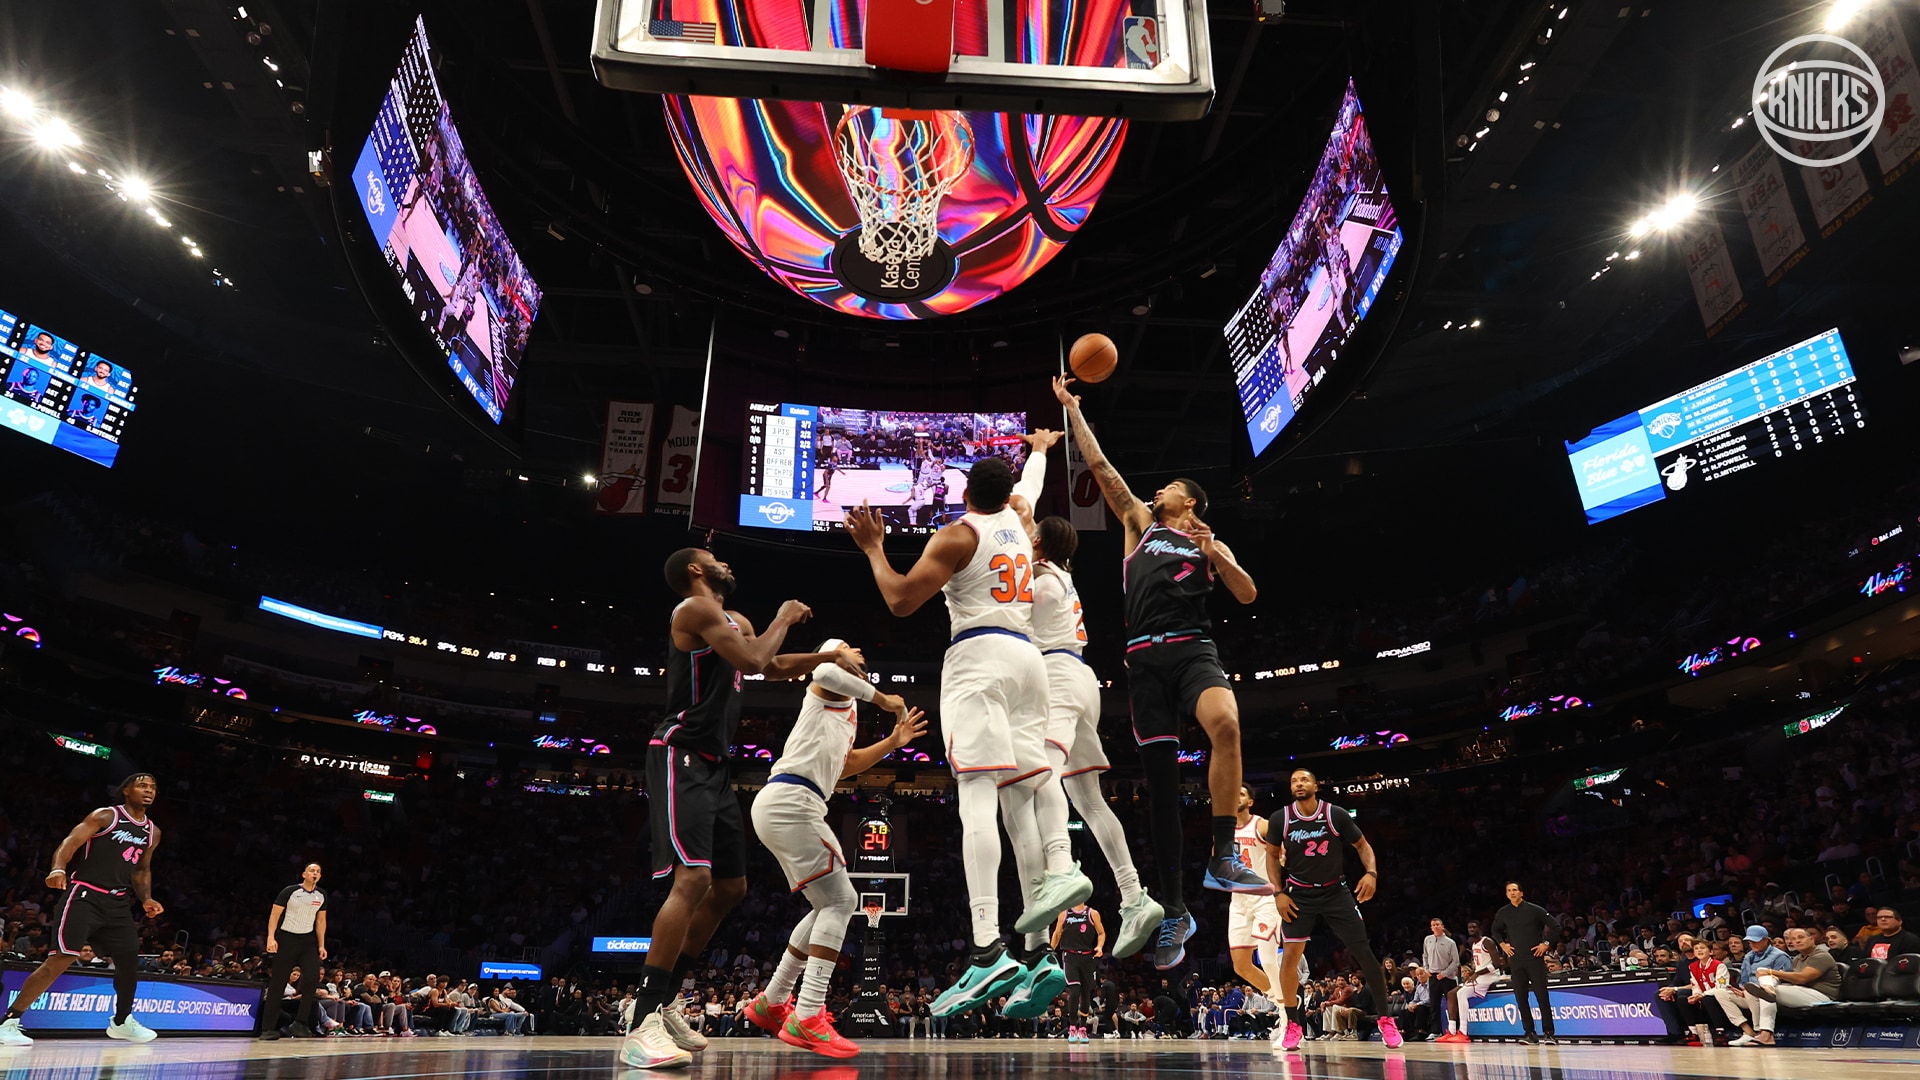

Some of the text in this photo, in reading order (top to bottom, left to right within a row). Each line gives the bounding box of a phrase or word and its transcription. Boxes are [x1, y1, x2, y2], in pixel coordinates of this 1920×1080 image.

[1312, 365, 1326, 387] MIA
[1362, 296, 1370, 311] 10
[1371, 267, 1385, 296] NYK
[402, 278, 415, 305] MIA
[453, 359, 462, 374] 10
[463, 374, 478, 397] NYK
[749, 403, 779, 413] HEAT
[1825, 401, 1835, 409] -1
[617, 416, 642, 424] CULP
[749, 415, 812, 429] 4/11 3/7
[1702, 432, 1732, 446] K.WARE
[1822, 392, 1832, 400] -1
[800, 430, 812, 439] 2/2
[752, 446, 758, 454] 3
[800, 440, 811, 449] 2/2
[751, 456, 756, 464] 2
[1582, 443, 1640, 473] Florida
[1710, 454, 1748, 470] N.POWELL
[750, 466, 756, 474] 3
[1586, 467, 1618, 487] Blue
[1714, 460, 1757, 479] D.MITCHELL
[885, 525, 892, 534] 9
[1143, 539, 1201, 558] Miami
[989, 553, 1034, 604] 32
[1173, 561, 1196, 583] 7
[1073, 600, 1088, 642] 2
[382, 630, 406, 642] FG%
[408, 636, 428, 646] 36.4
[437, 642, 458, 652] 3P%
[460, 646, 480, 657] 25.0
[487, 651, 507, 660] AST
[537, 657, 556, 667] REB
[586, 663, 605, 672] BLK
[634, 667, 651, 676] TOL
[1376, 641, 1431, 658] AROMA360
[1254, 670, 1274, 680] 3P%
[1274, 667, 1296, 677] 100.0
[1299, 663, 1319, 673] FG%
[1322, 660, 1340, 669] 42.9
[111, 829, 148, 846] Miami
[869, 825, 888, 834] 7:13
[1288, 826, 1328, 844] Miami
[864, 833, 886, 850] 24
[1304, 840, 1330, 857] 24
[122, 846, 143, 864] 45
[1080, 924, 1087, 933] 9
[8, 990, 49, 1010] WCH
[48, 992, 70, 1010] THE
[69, 993, 98, 1012] HEAT
[95, 994, 112, 1012] ON
[177, 1000, 212, 1014] SPORTS
[211, 1002, 252, 1016] NETWORK
[1478, 1008, 1495, 1022] HEAT
[1495, 1007, 1505, 1021] ON
[1560, 1004, 1598, 1020] SPORTS
[1600, 1003, 1654, 1018] NETWORK
